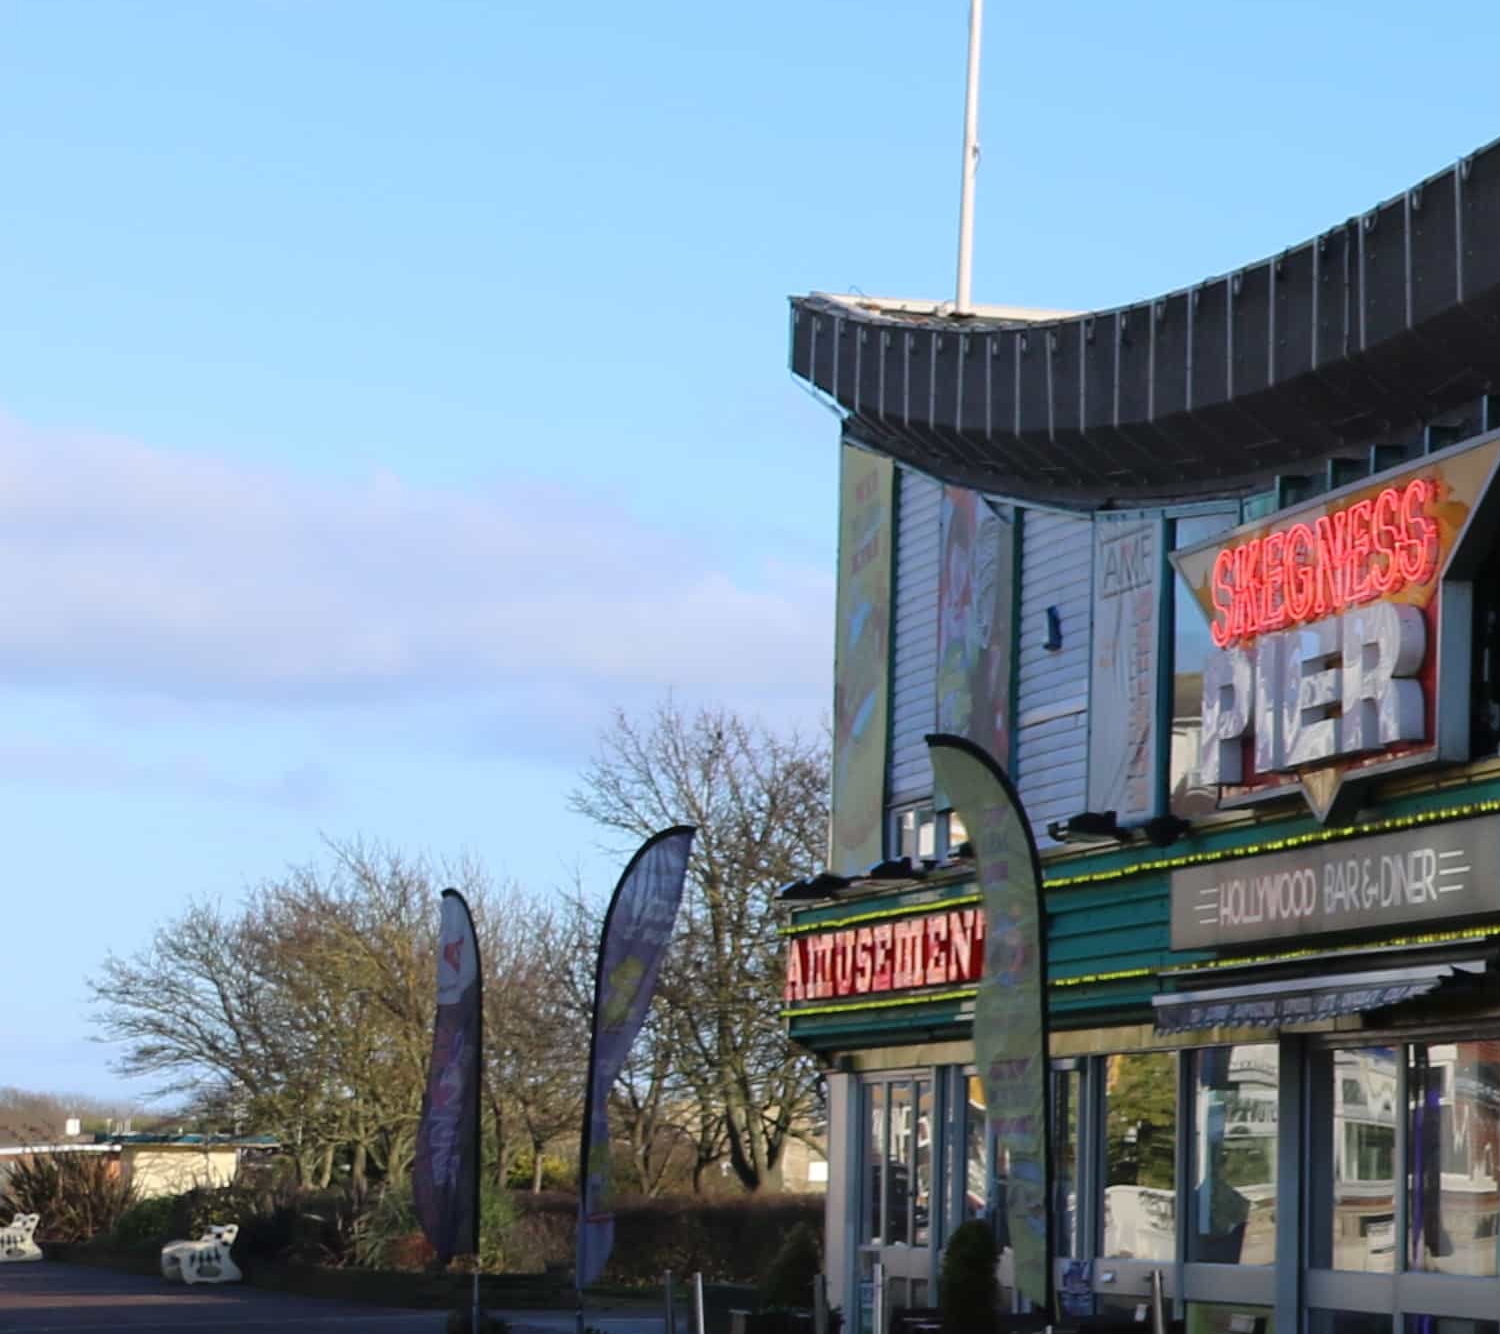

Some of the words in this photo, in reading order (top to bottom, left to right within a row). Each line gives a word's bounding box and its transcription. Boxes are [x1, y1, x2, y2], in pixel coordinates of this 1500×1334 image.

[1211, 478, 1438, 650] SKEGNESS
[1203, 601, 1426, 786] PIER
[1219, 868, 1316, 927] HOLLYWOOD
[1324, 861, 1357, 914] BAR
[1380, 847, 1438, 909] DINER
